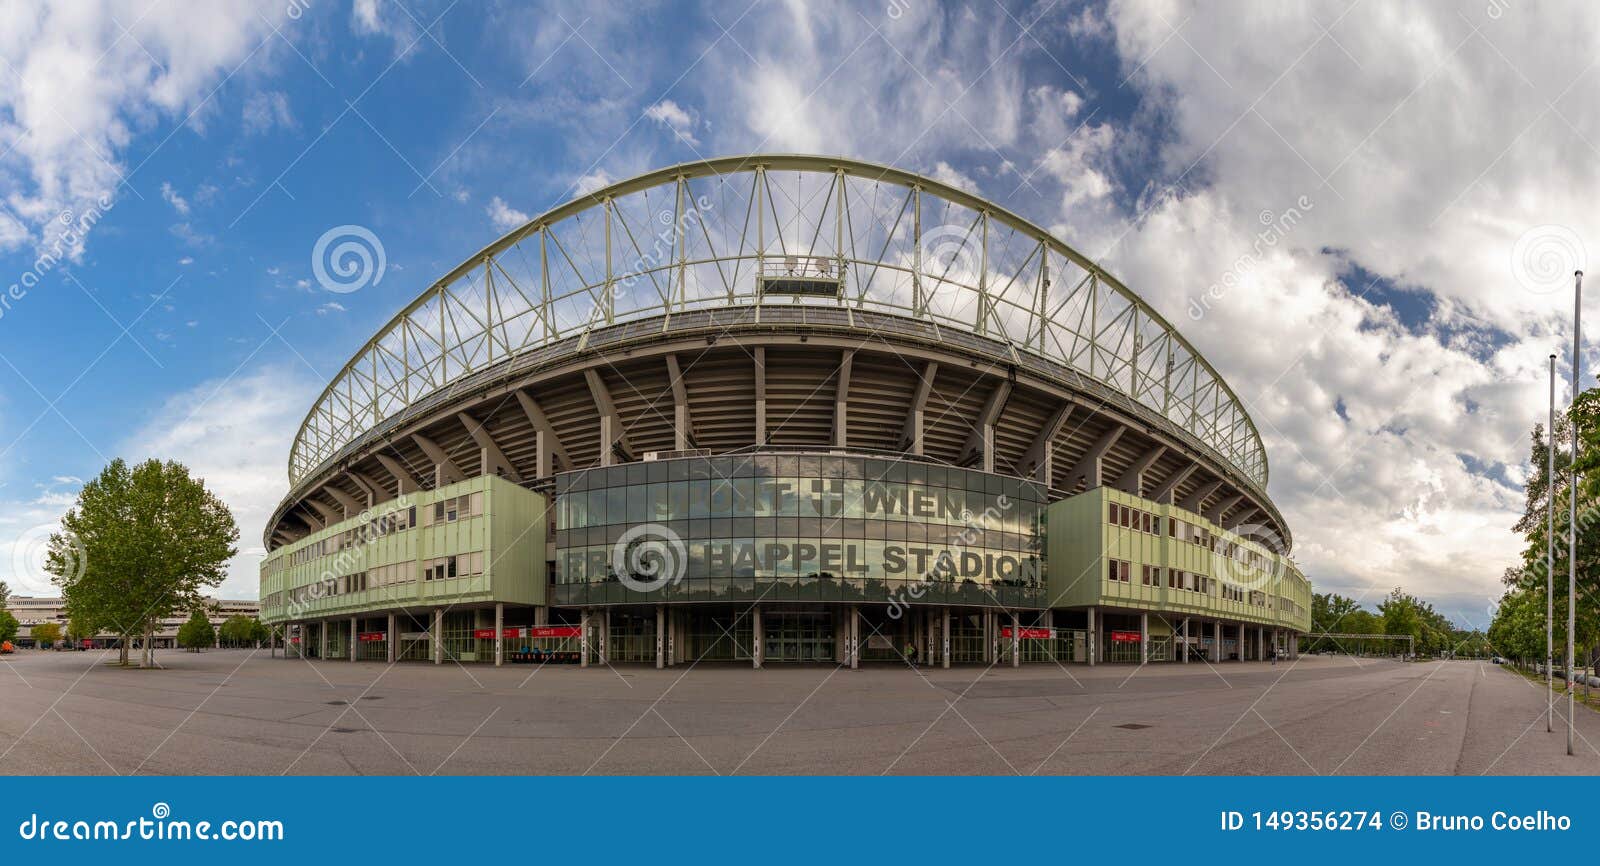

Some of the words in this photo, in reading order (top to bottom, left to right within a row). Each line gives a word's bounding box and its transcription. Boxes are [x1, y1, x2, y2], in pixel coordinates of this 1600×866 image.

[863, 484, 966, 521] WIEN
[703, 543, 870, 573] HAPPEL
[882, 546, 1042, 586] STADION
